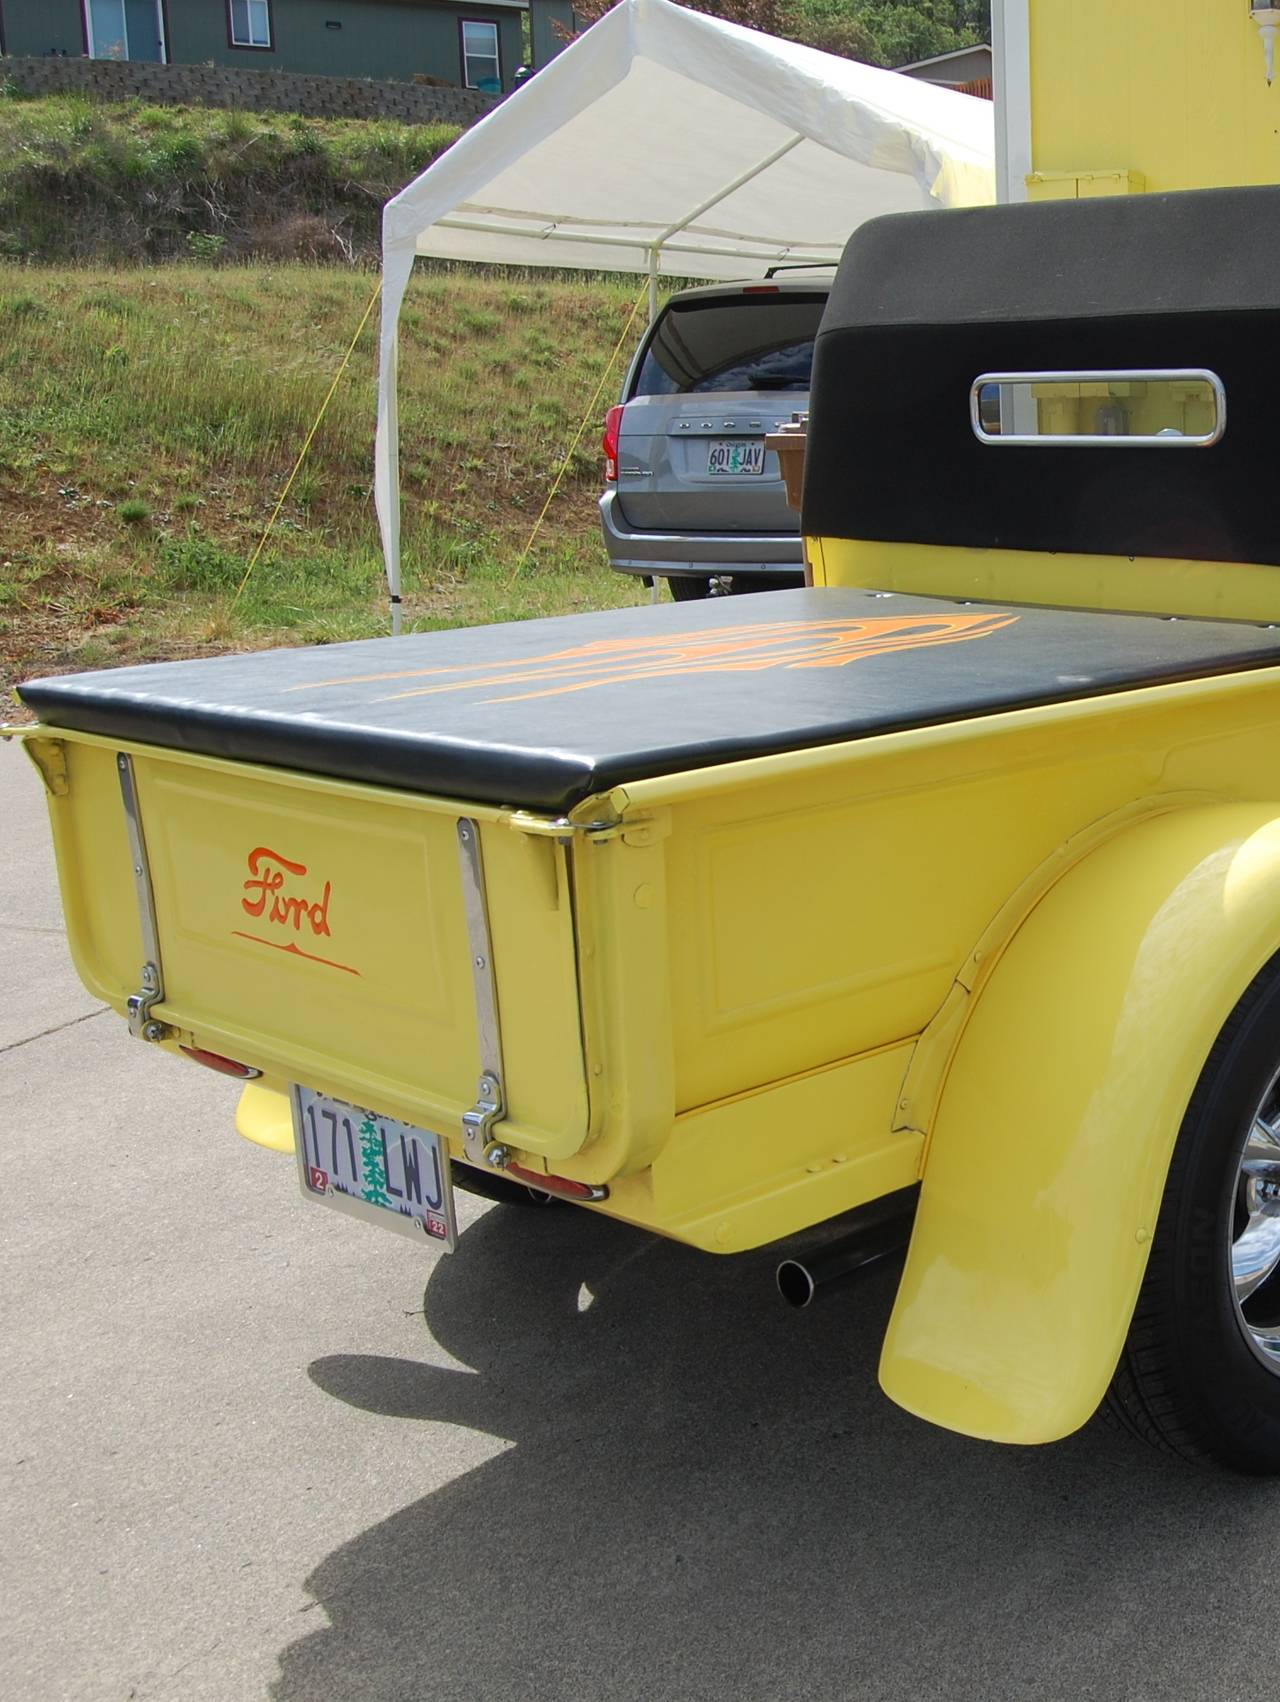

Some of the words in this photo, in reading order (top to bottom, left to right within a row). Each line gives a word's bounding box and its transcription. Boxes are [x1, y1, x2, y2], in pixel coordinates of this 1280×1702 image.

[709, 448, 730, 466] 601
[738, 447, 762, 466] JAV
[241, 846, 331, 937] Ford
[307, 1105, 358, 1182] 171
[380, 1127, 443, 1211] LWJ
[315, 1173, 325, 1190] 2
[431, 1220, 445, 1235] 22
